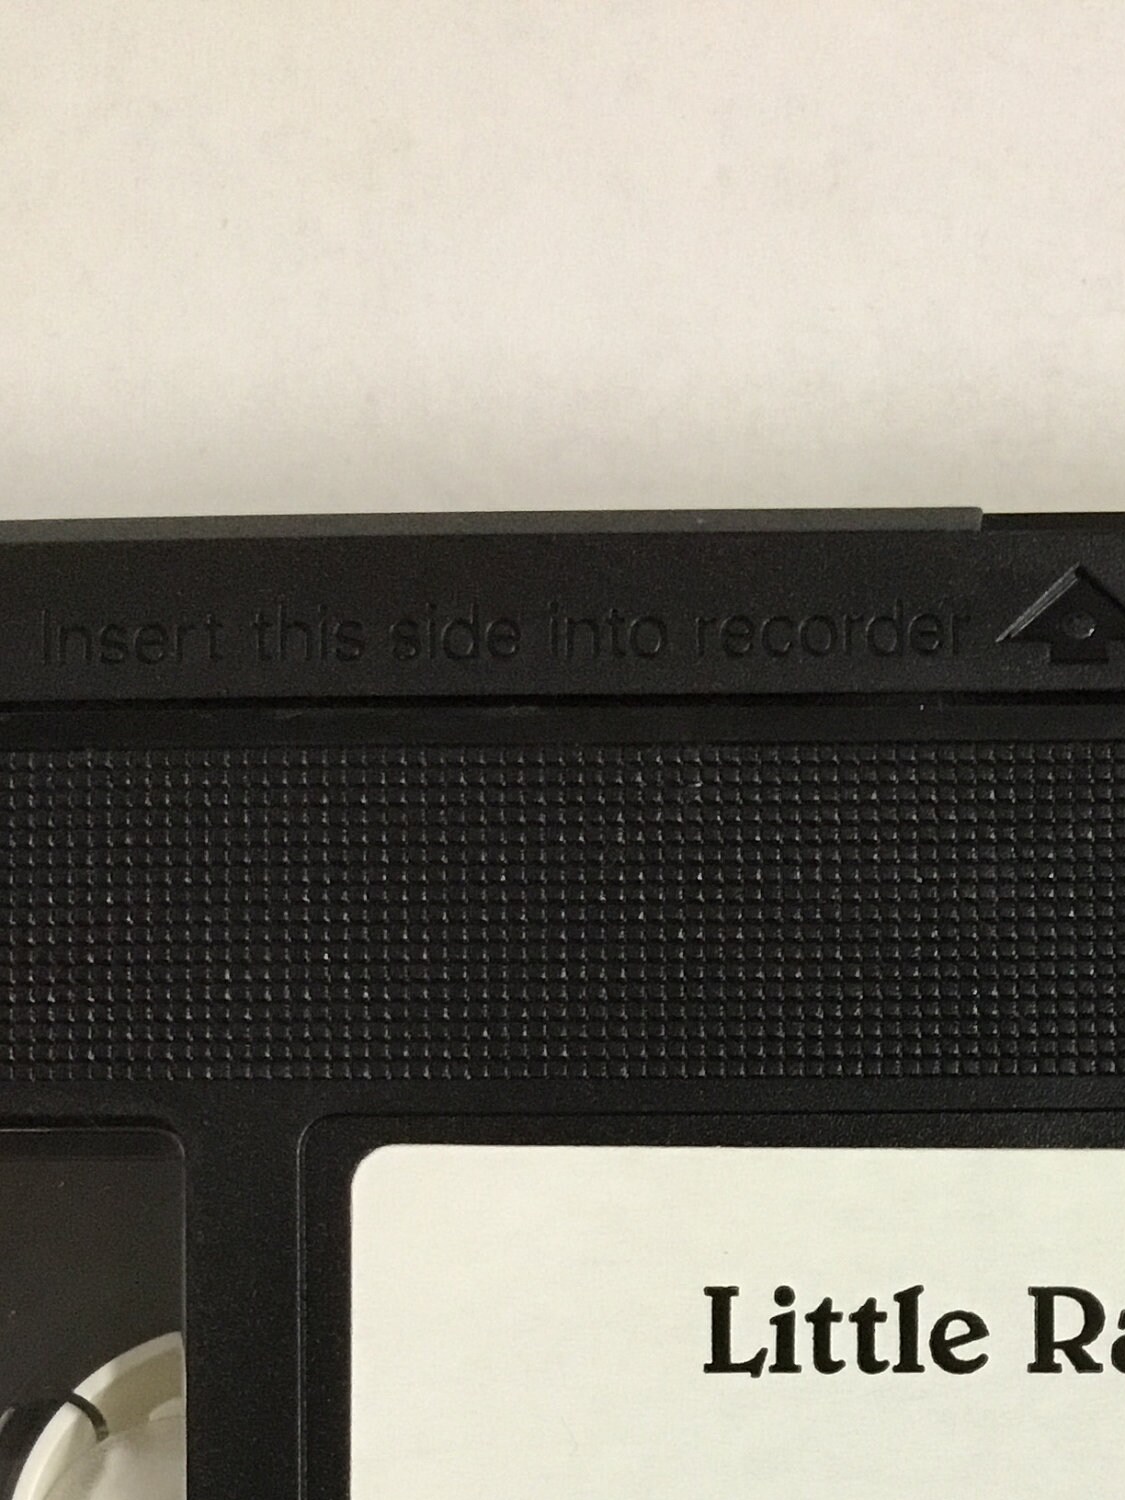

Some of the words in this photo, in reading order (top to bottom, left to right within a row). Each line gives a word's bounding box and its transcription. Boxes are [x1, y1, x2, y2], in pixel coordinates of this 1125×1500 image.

[40, 609, 224, 664] Insert
[254, 603, 365, 661] this
[391, 602, 522, 661] side
[548, 600, 668, 660] into
[694, 599, 971, 658] recorder
[703, 1285, 990, 1379] Little
